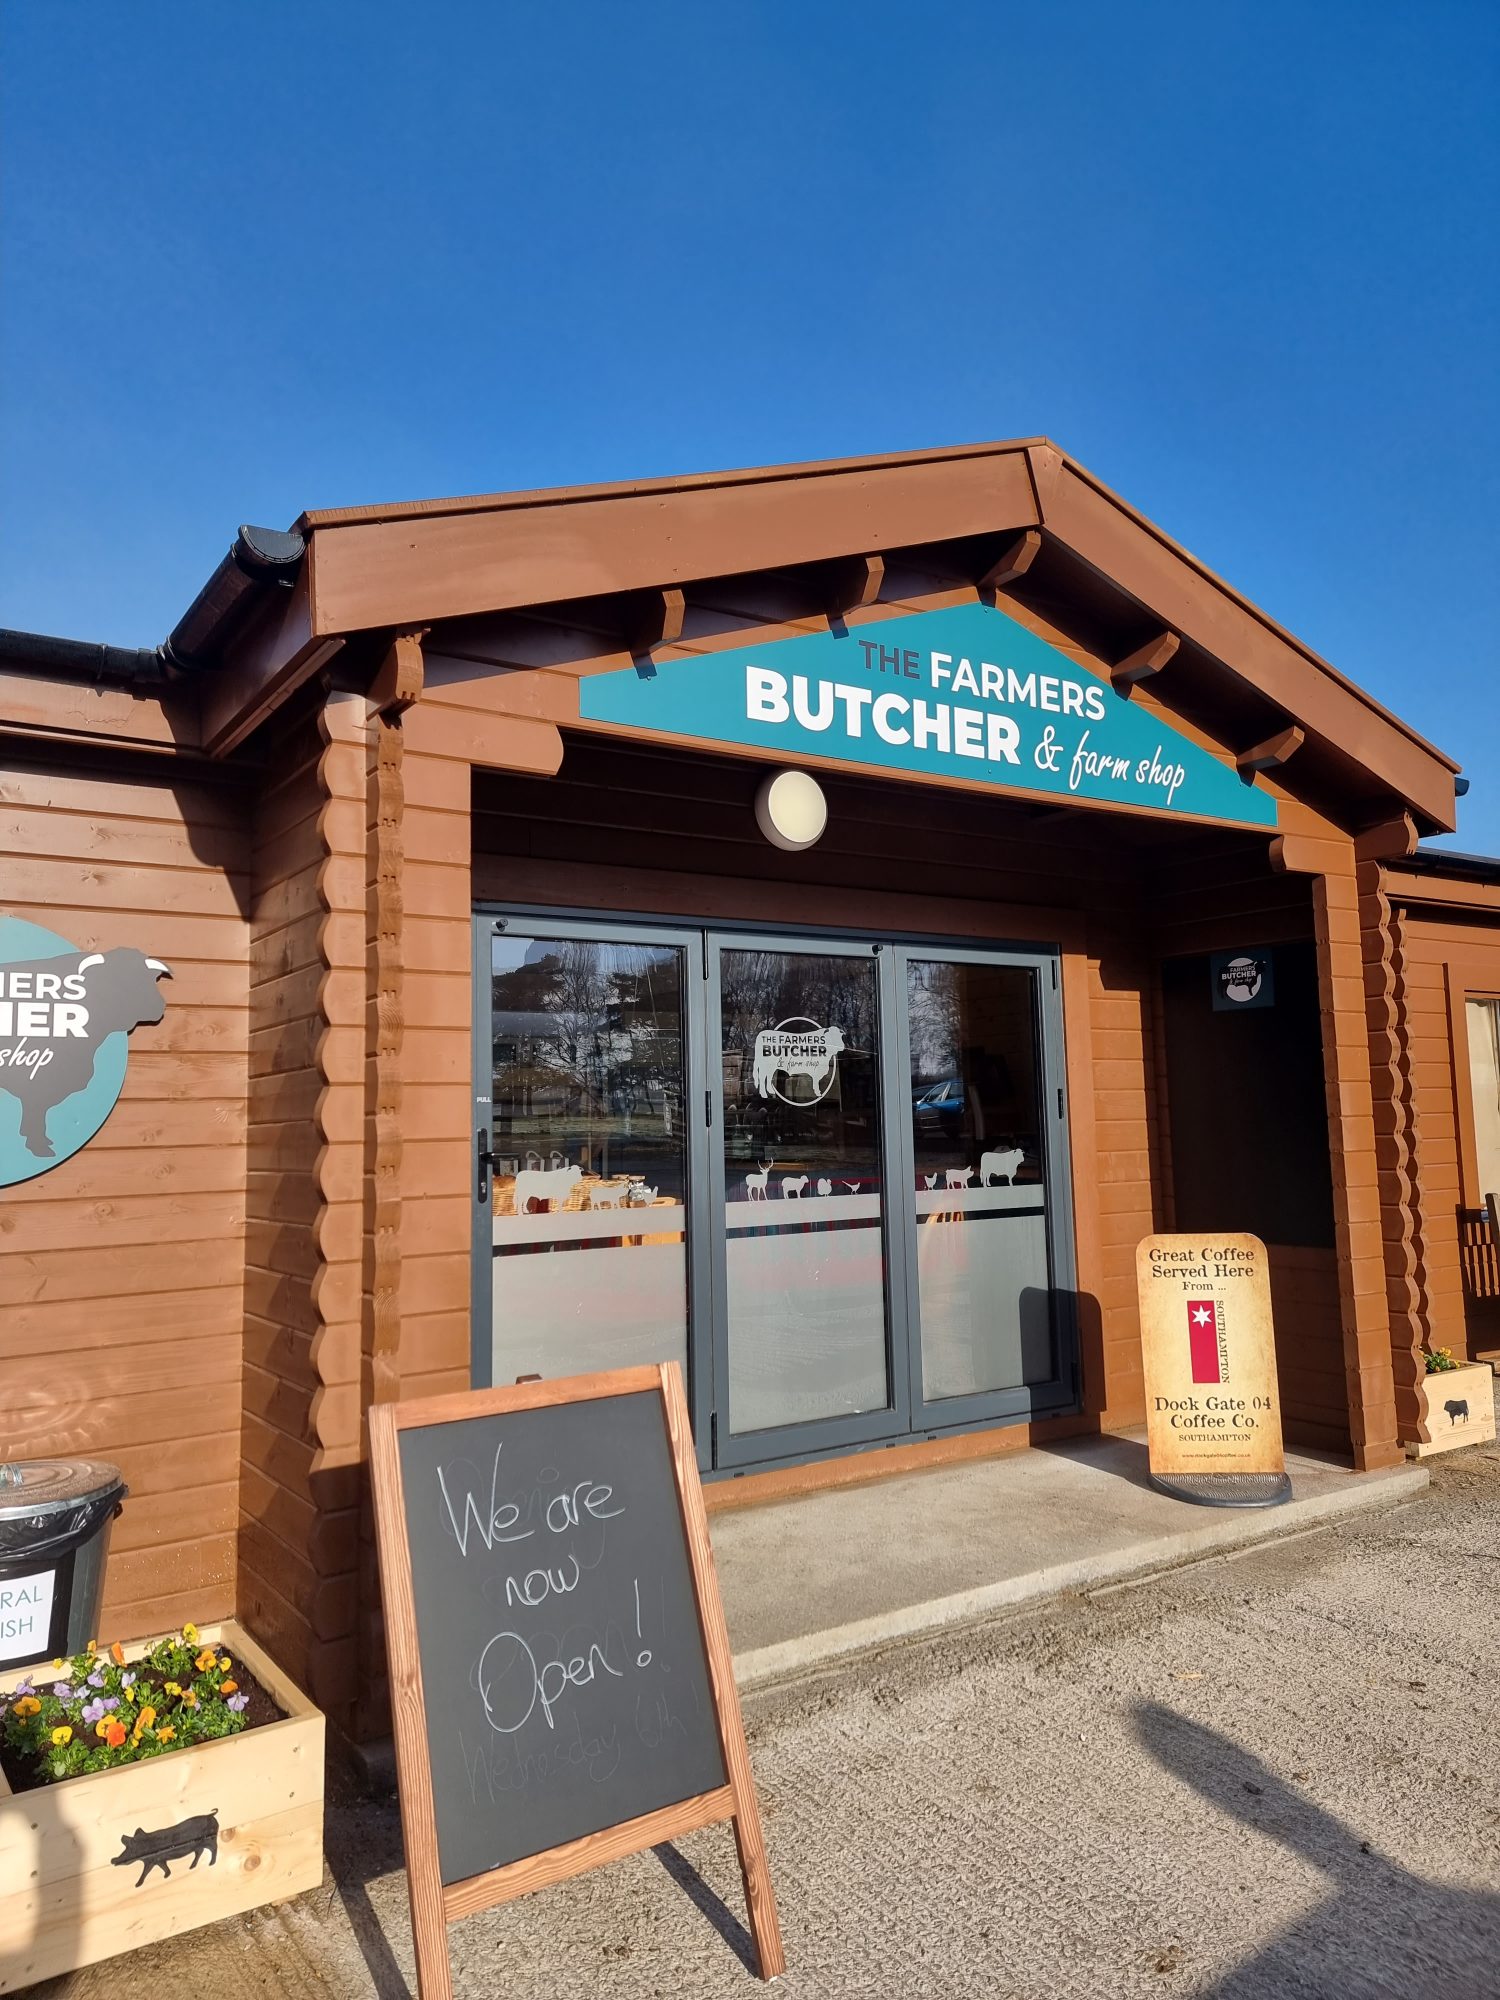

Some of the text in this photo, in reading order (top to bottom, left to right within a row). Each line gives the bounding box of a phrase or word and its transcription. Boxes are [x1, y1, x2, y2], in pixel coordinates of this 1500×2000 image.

[858, 639, 1106, 721] THE FARMERS
[745, 665, 1186, 805] BUTCHER & farm shop
[1221, 970, 1257, 980] BUTCHER
[779, 1035, 826, 1045] FARMERS
[762, 1045, 827, 1057] BUTCHER
[1149, 1247, 1255, 1262] Great Coffee
[1152, 1264, 1254, 1278] Served Here
[1182, 1281, 1214, 1291] From
[1216, 1300, 1230, 1384] SOUTHAMPTON
[1154, 1396, 1272, 1411] Dock Gate 04
[1170, 1413, 1259, 1428] Coffee Co.
[1178, 1433, 1252, 1441] SOUTHAMPTON
[437, 1441, 535, 1557] We
[546, 1480, 625, 1533] are
[505, 1554, 580, 1607] now
